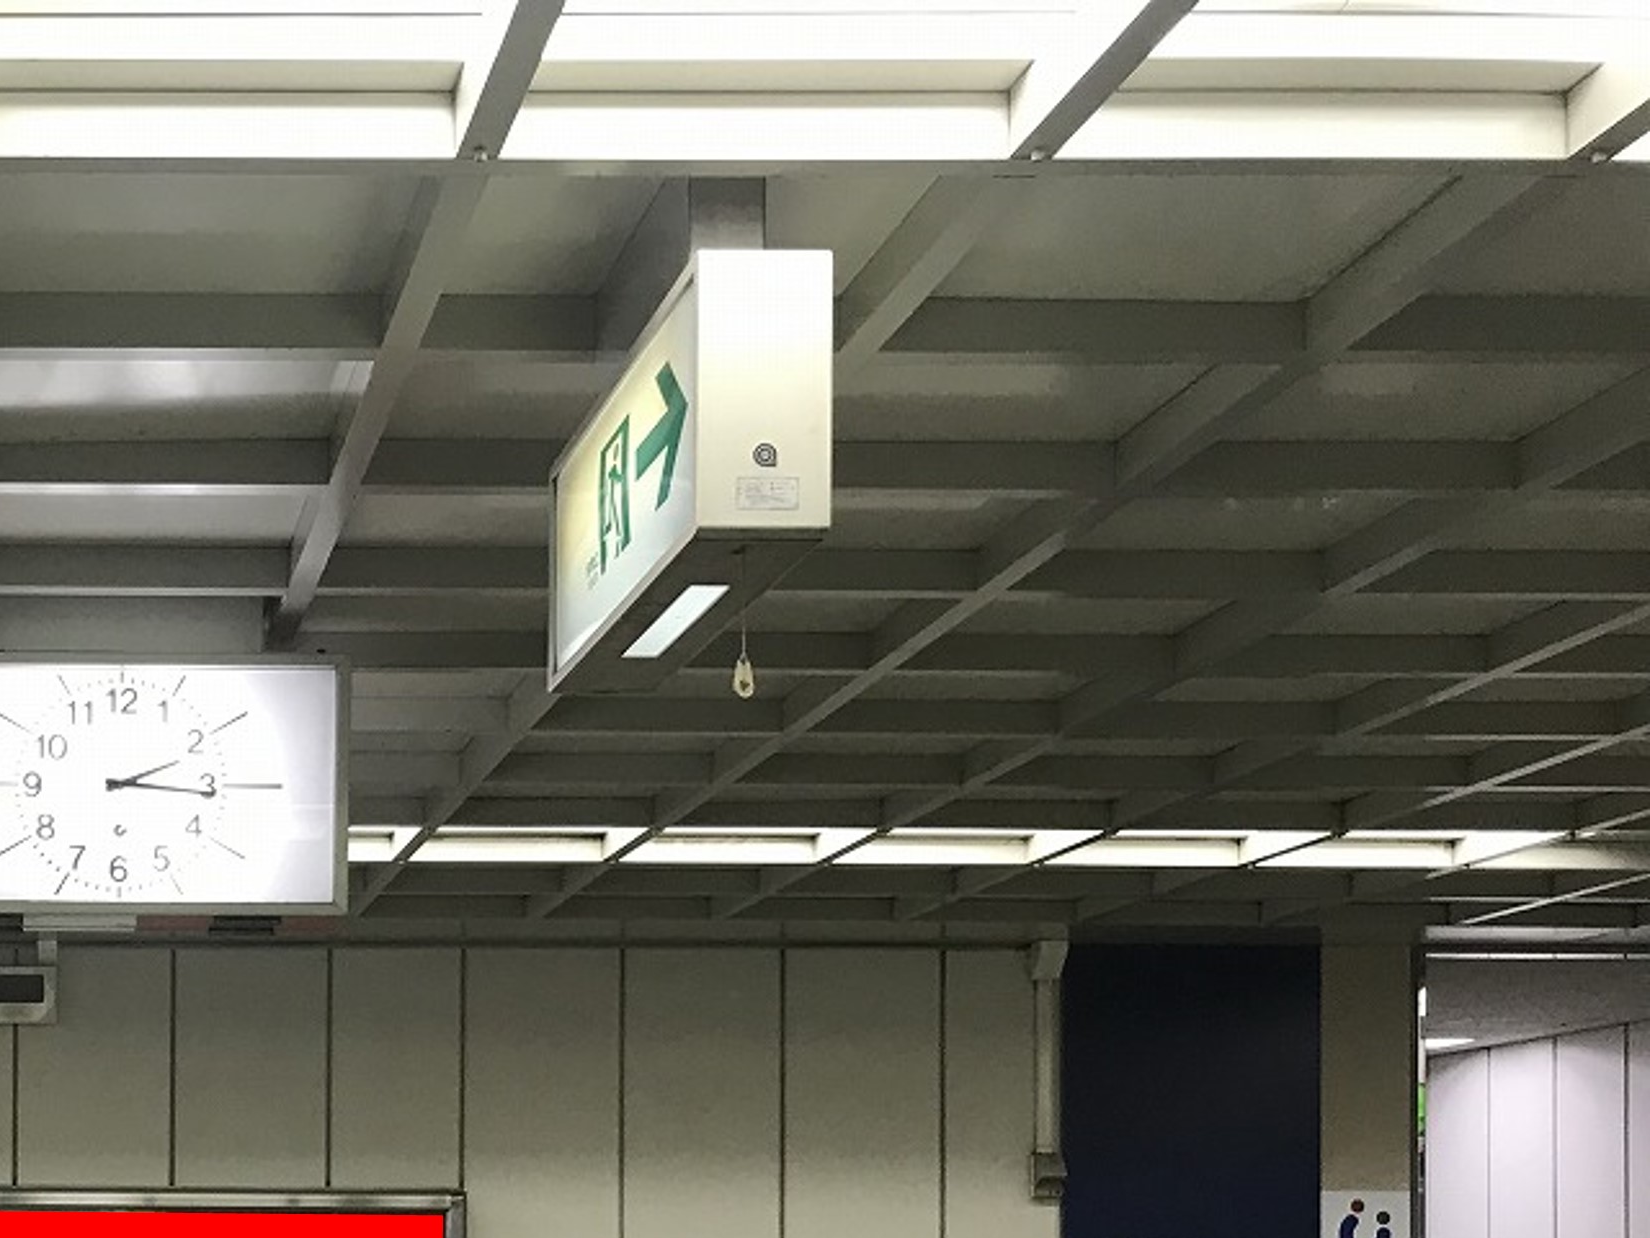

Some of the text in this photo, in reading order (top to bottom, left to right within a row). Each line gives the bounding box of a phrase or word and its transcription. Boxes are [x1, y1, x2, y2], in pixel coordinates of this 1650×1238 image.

[67, 701, 94, 724] 11
[107, 688, 138, 714] 12
[158, 700, 170, 722] 1
[37, 734, 68, 760] 10
[187, 729, 204, 754] 2
[23, 772, 42, 798] 9
[199, 773, 217, 798] 3
[36, 814, 56, 840] 8
[184, 814, 202, 837] 4
[69, 845, 86, 871] 7
[108, 856, 128, 882] 6
[153, 845, 171, 872] 5
